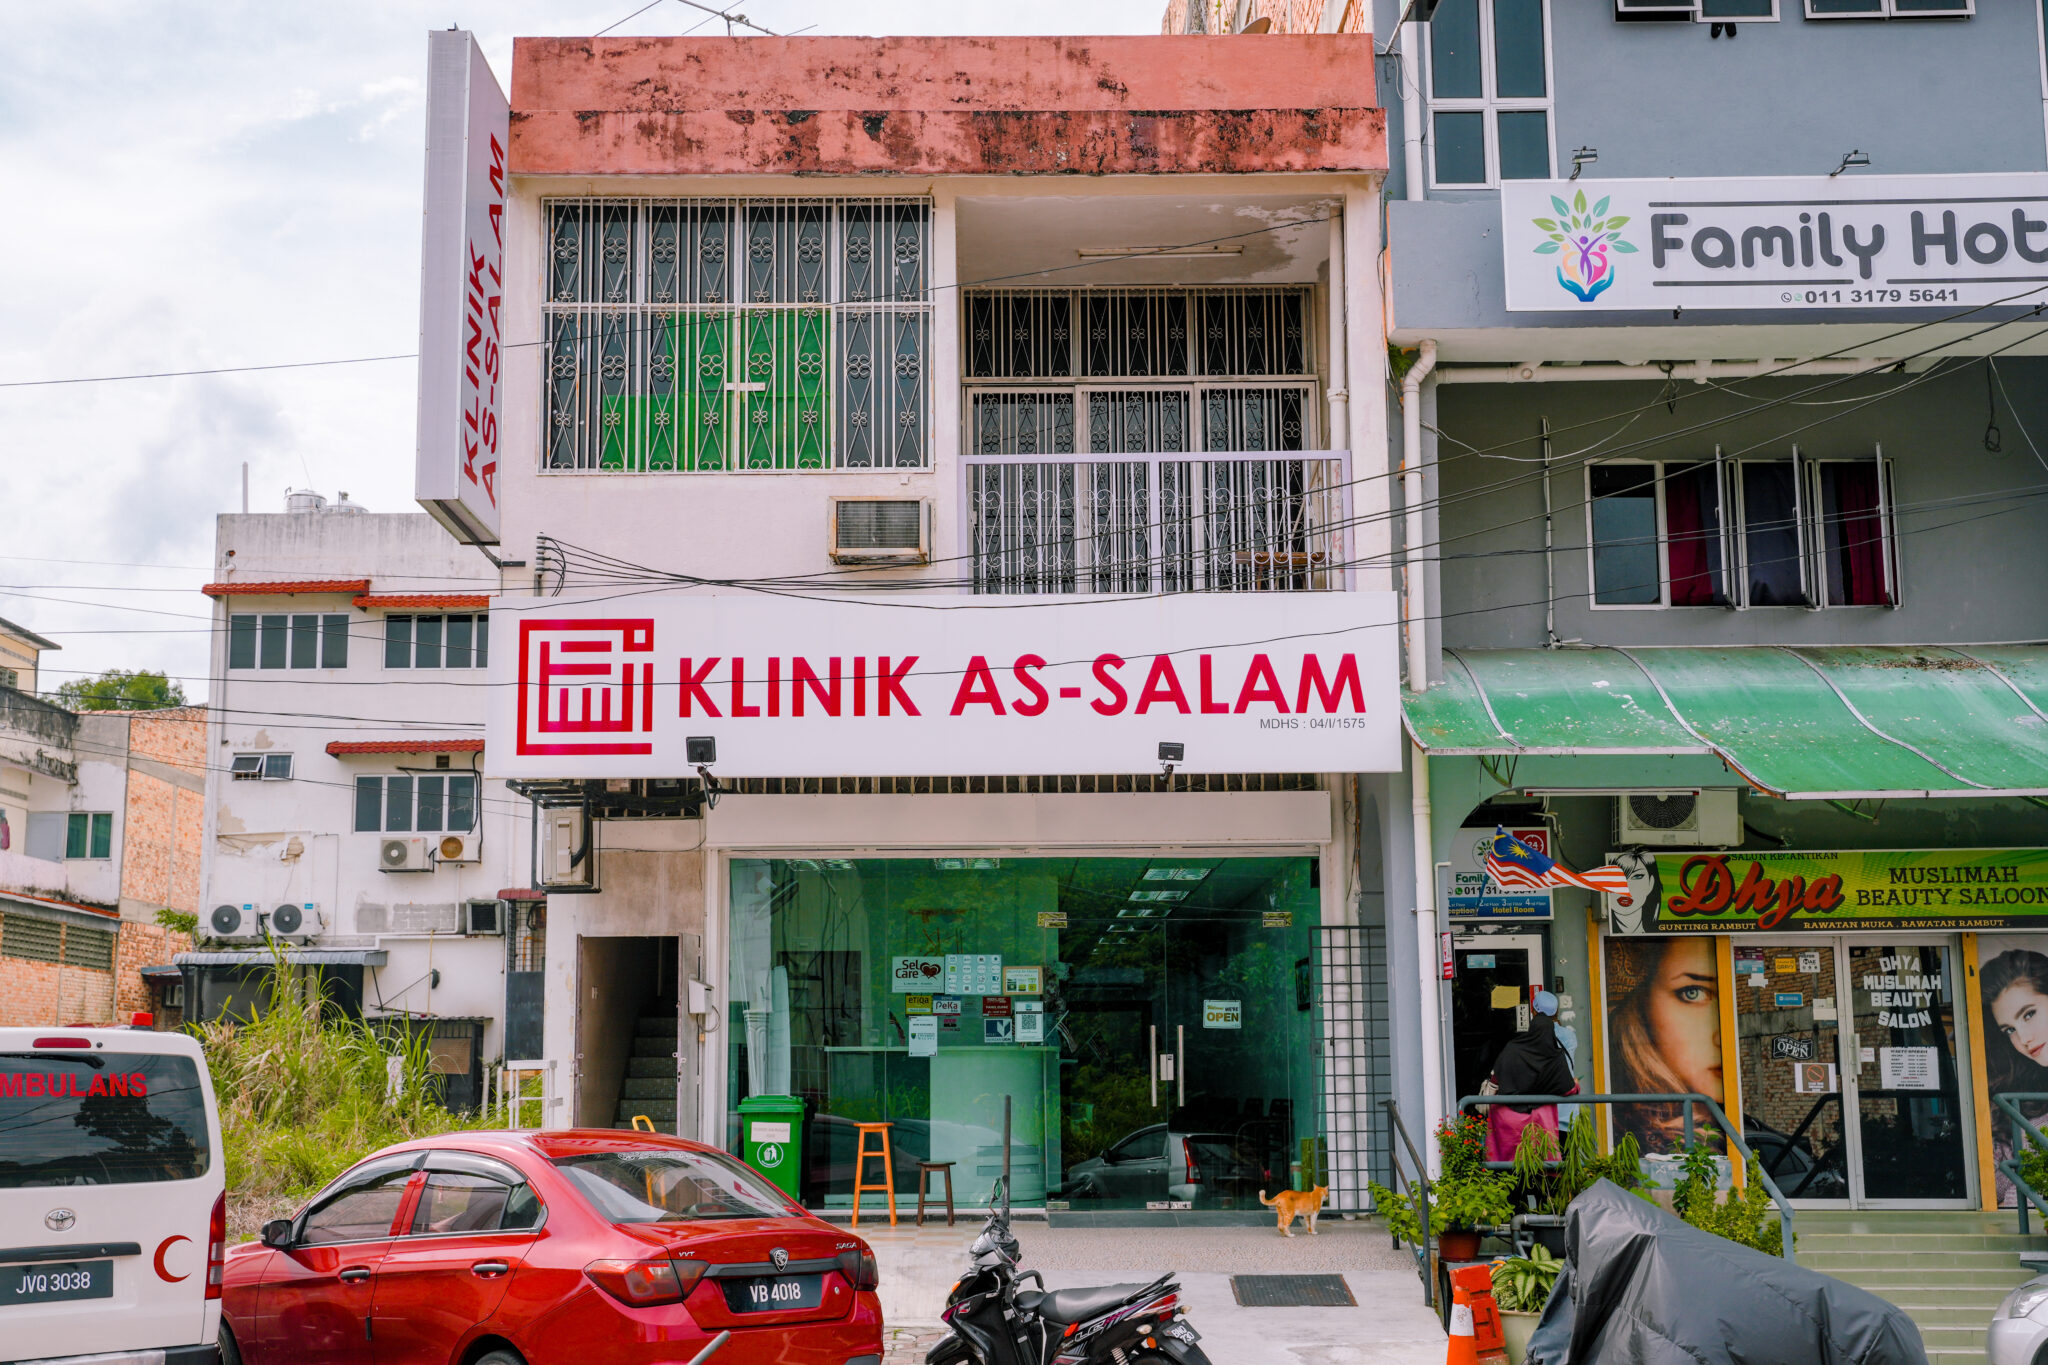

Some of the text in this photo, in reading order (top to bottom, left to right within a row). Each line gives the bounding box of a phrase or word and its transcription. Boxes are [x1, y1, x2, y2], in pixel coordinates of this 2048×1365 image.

[1650, 211, 1886, 280] Family
[1804, 288, 1959, 304] 011 3179 5641
[481, 132, 504, 509] AS-SALAM
[463, 240, 485, 486] KLINIK
[679, 652, 1367, 719] KLINIK AS-SALAM
[1259, 717, 1299, 730] MDHS
[1309, 717, 1366, 730] 04/I/1575
[1888, 865, 2020, 885] MUSLIMAH
[1668, 854, 1844, 930] Dhya
[1855, 886, 2048, 906] BEAUTY SALOON
[1492, 906, 1513, 914] Hotel
[1658, 922, 1756, 931] GUNTING RAMBUT
[1803, 919, 2005, 929] RAWATAN MUKA RAWATAN RAMBUT
[902, 959, 919, 970] Sel
[1879, 955, 1921, 973] DHYA
[895, 968, 919, 979] Care
[1863, 975, 1942, 990] MUSLIMAH
[1870, 991, 1933, 1007] BEAUTY
[1206, 1012, 1239, 1023] OPEN
[1877, 1009, 1933, 1029] SALON
[1777, 1041, 1808, 1058] OPEN
[835, 1242, 857, 1250] SAGA
[15, 1271, 91, 1294] JVQ 3038
[750, 1282, 802, 1304] VB 4018
